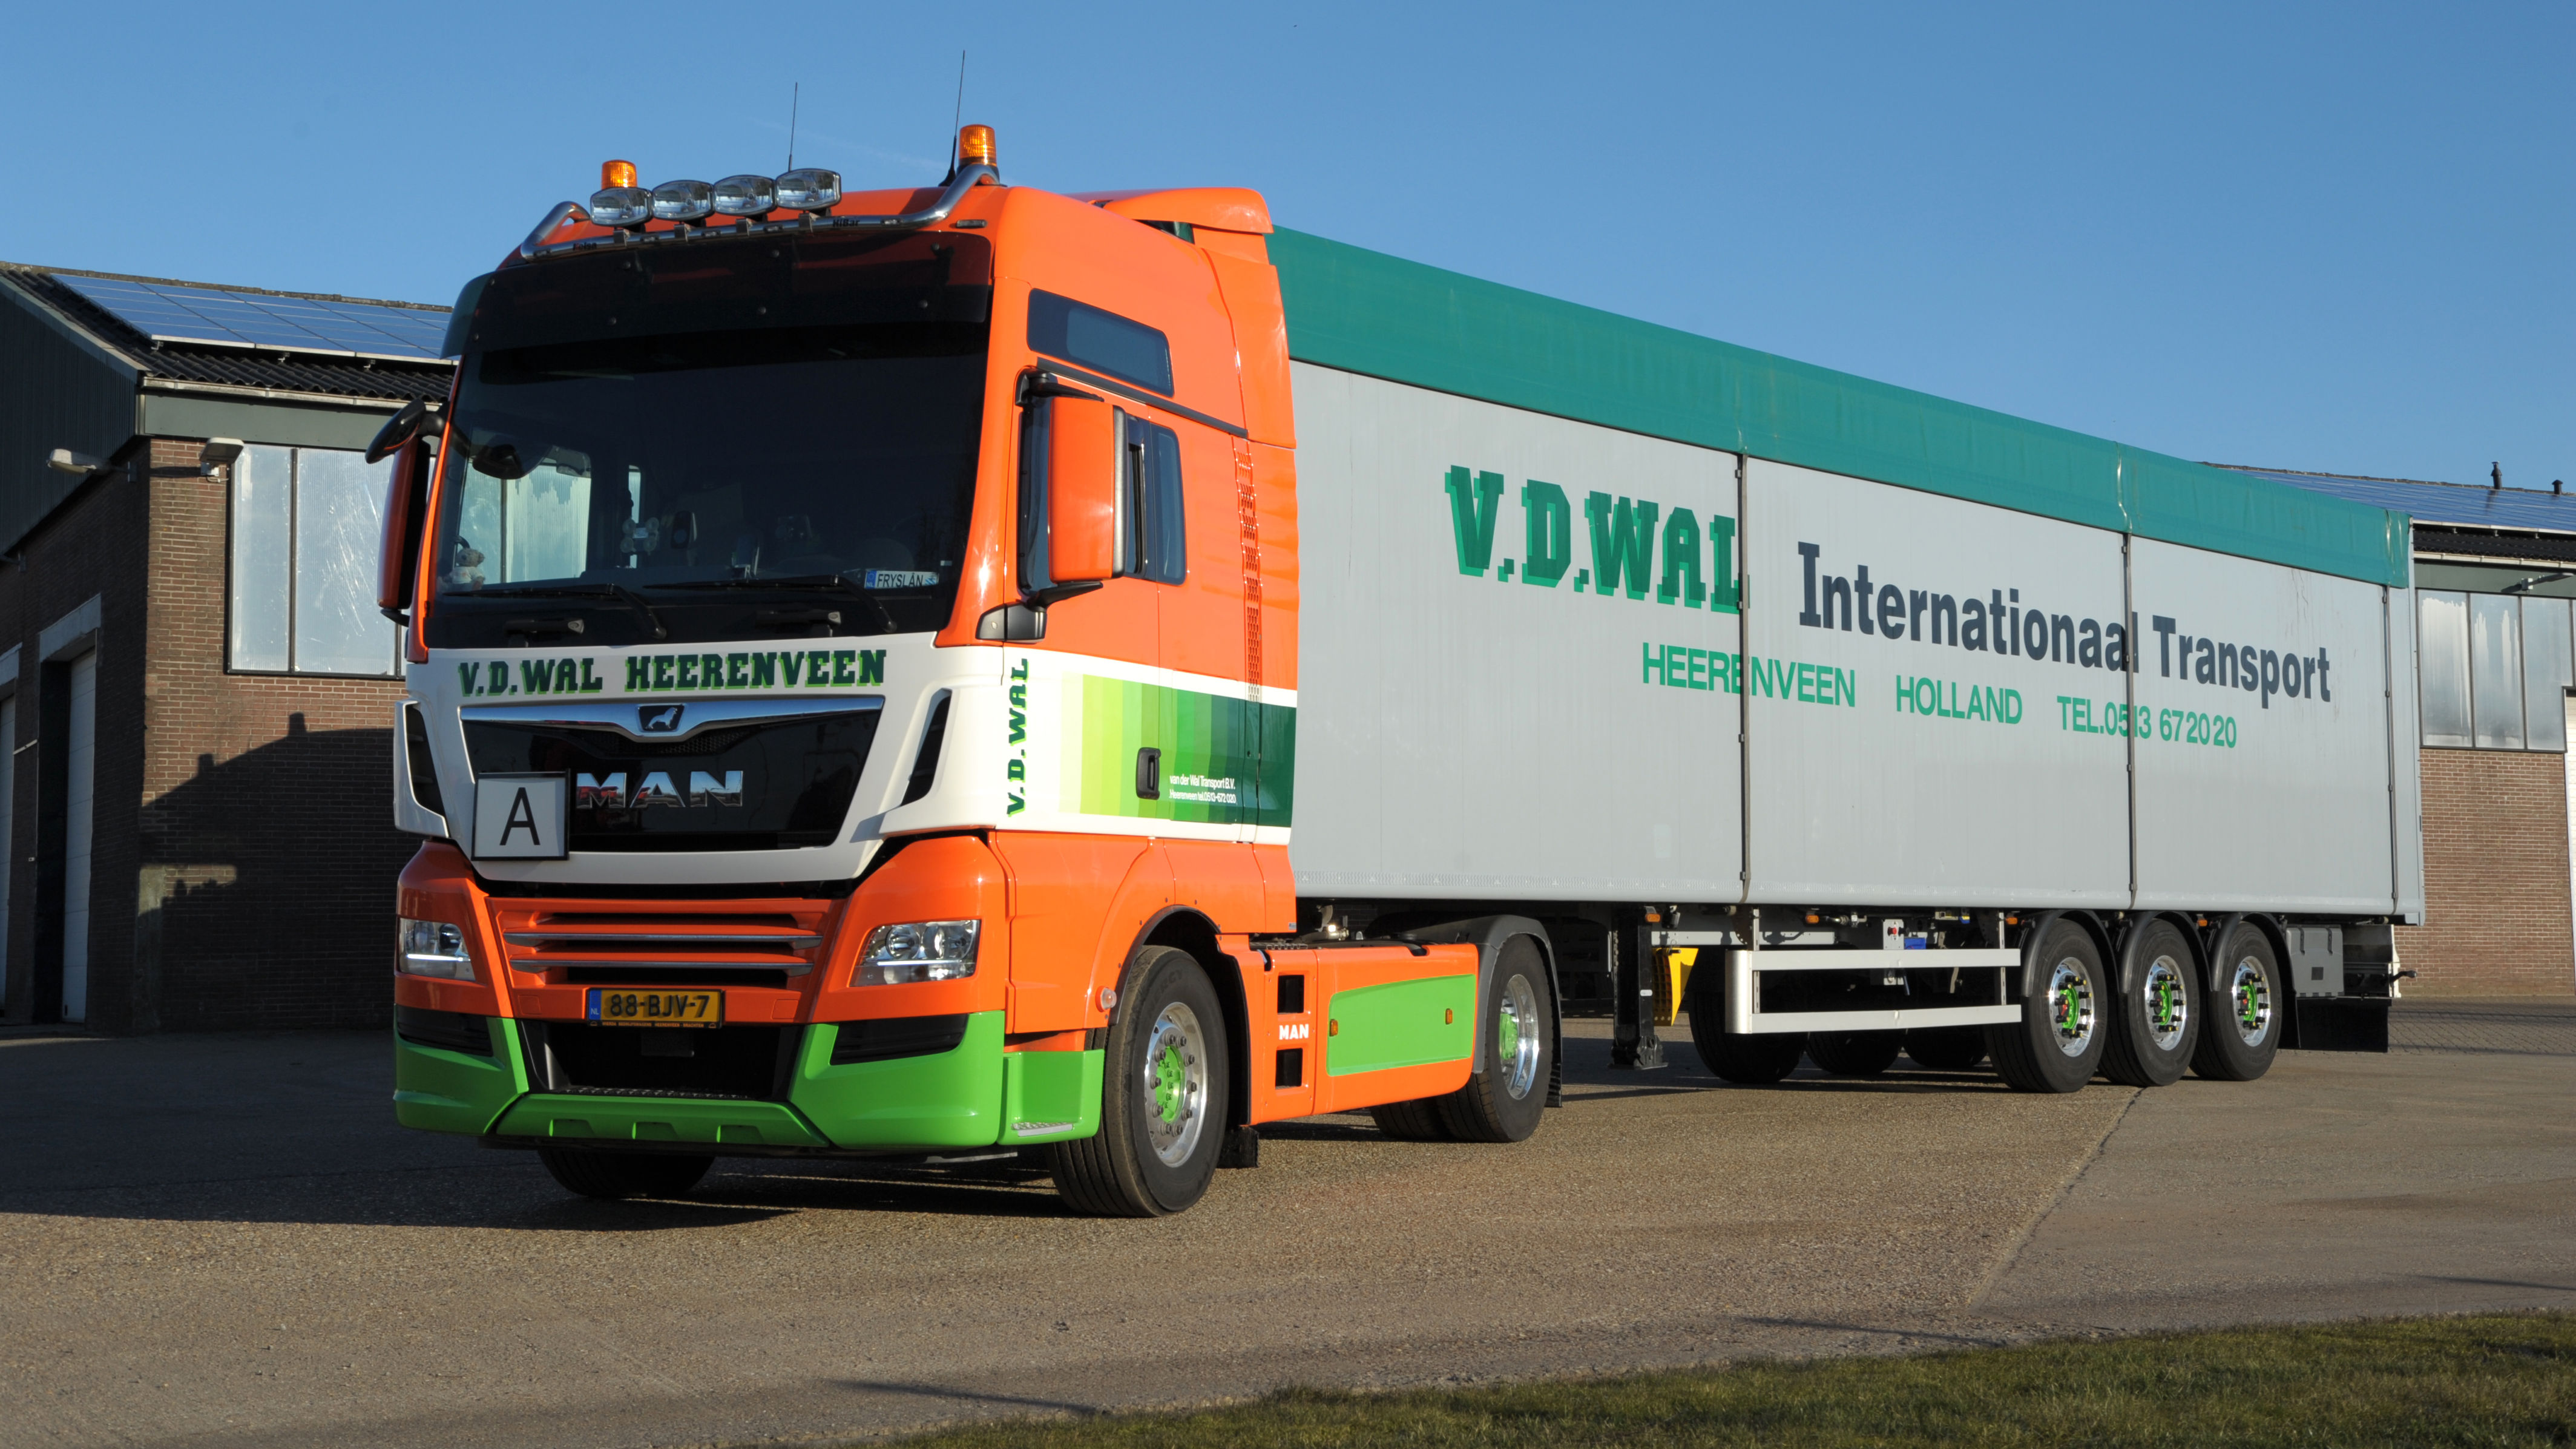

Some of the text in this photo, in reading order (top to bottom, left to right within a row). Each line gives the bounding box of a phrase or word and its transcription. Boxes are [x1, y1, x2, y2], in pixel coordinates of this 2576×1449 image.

[1445, 464, 1750, 615] V.D.WAL
[1798, 541, 2331, 709] Internationaal Transport
[458, 649, 887, 697] V.D.WAL HEERENVEEN
[1643, 642, 1856, 708] HEERENVEEN
[1896, 674, 2023, 725] HOLLAND
[1007, 658, 1029, 817] V.D.WAL
[576, 770, 743, 809] MAN
[1169, 774, 1236, 790] van der Wal Transport B.V.
[1169, 789, 1197, 801] Heerenveen
[499, 786, 540, 846] A
[610, 994, 711, 1018] 88-BJV-7
[1279, 1024, 1309, 1040] MAN
